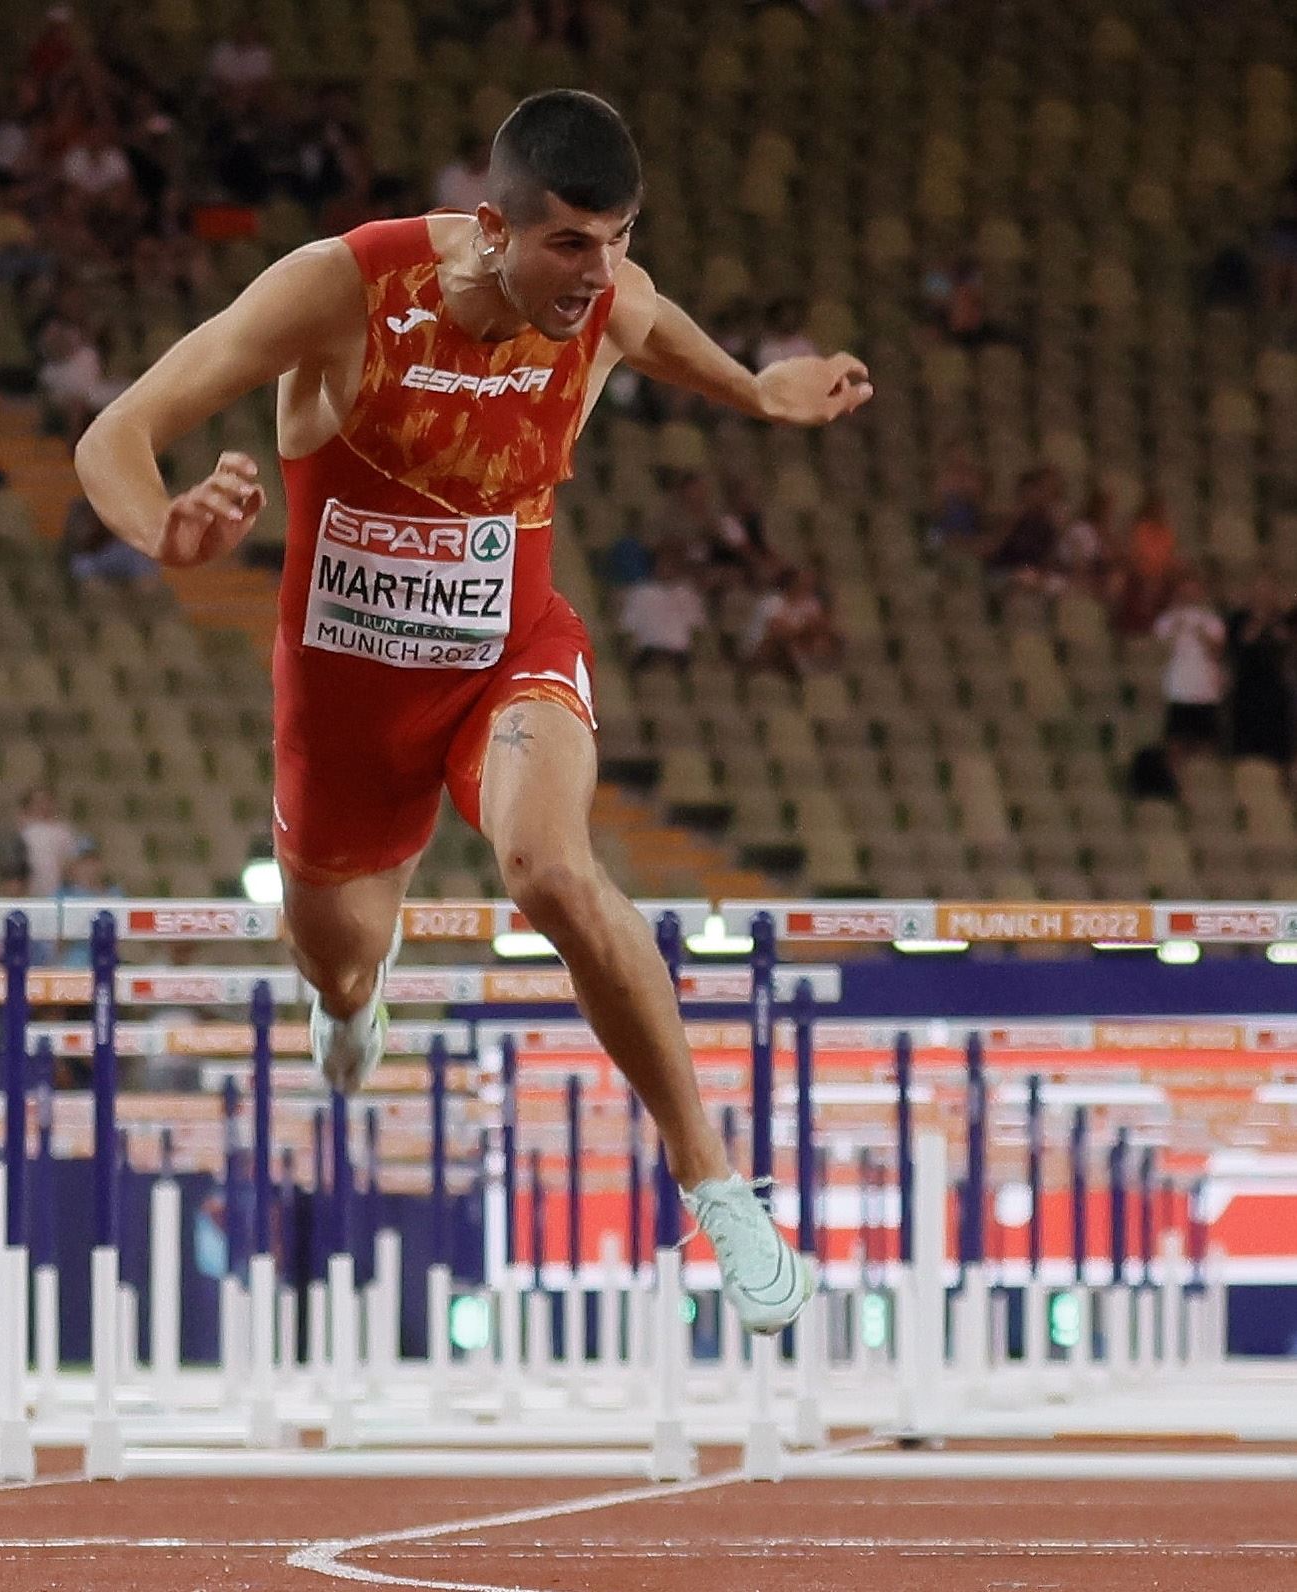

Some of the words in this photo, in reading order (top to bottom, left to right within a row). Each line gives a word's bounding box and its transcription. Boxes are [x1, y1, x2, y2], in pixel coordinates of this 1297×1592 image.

[402, 365, 553, 398] ESPAÑA
[329, 512, 464, 557] SPAR
[318, 555, 504, 617] MARTÍNEZ
[363, 616, 397, 633] RUN
[403, 624, 457, 639] CLEAN
[318, 622, 419, 661] MUNICH
[430, 643, 492, 663] 2022
[156, 912, 238, 935] SPAR
[413, 912, 480, 936] 2022
[812, 914, 891, 936] SPAR
[949, 913, 1062, 938] MUNICH
[1072, 912, 1139, 938] 2022
[1194, 914, 1276, 936] SPAR
